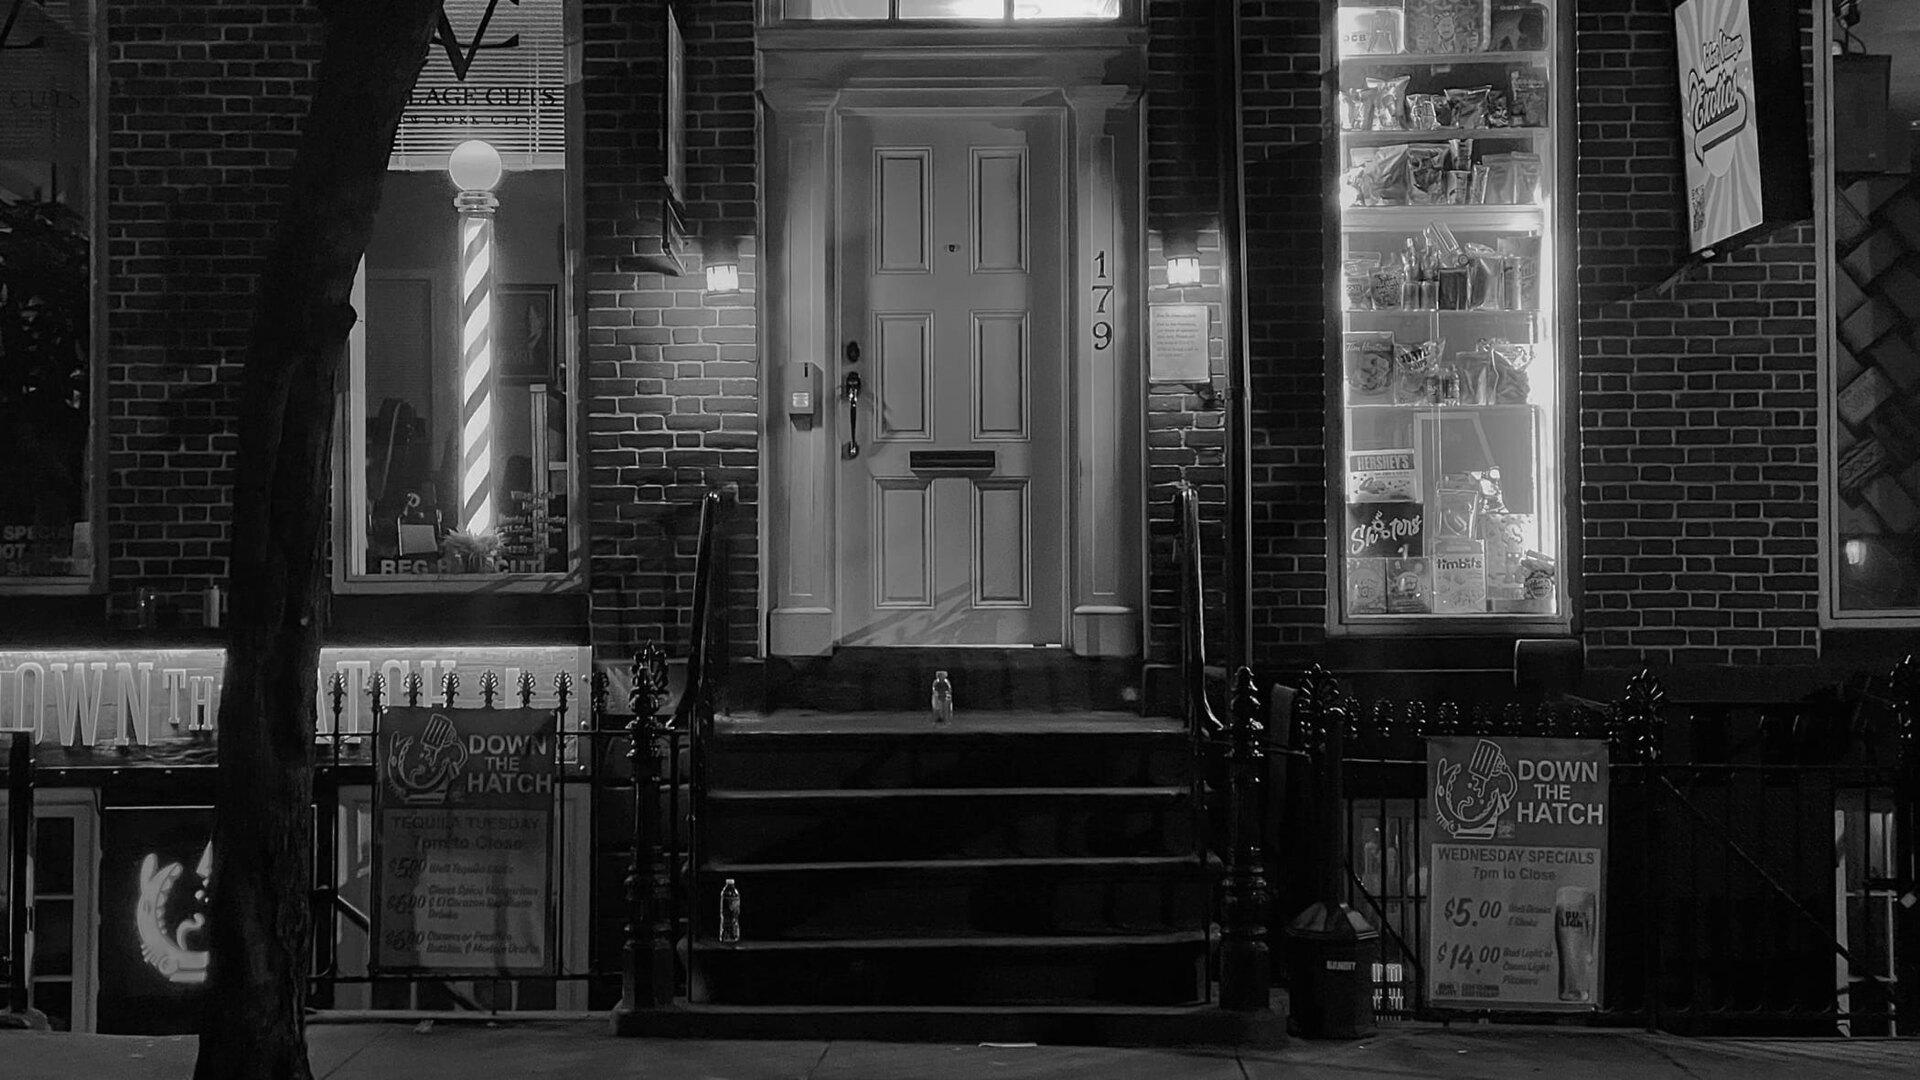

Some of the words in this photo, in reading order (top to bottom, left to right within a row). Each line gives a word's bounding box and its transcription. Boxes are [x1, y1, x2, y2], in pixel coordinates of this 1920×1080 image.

[487, 88, 557, 106] CUTS
[1092, 250, 1114, 350] 179
[1436, 557, 1482, 570] timbits
[468, 734, 547, 755] DOWN
[484, 757, 520, 771] THE
[1518, 760, 1598, 783] DOWN
[467, 772, 551, 793] HATCH
[1534, 784, 1571, 800] THE
[1517, 801, 1603, 825] HATCH
[391, 816, 460, 830] TEQUILA
[467, 816, 539, 830] TUESDAY
[454, 836, 469, 849] to
[1438, 847, 1525, 862] WEDNESDAY
[1528, 850, 1595, 865] SPECIALS
[1472, 867, 1499, 881] 7pm
[1503, 867, 1516, 880] to
[1519, 868, 1557, 881] Close
[1444, 897, 1502, 927] $5.00
[1436, 941, 1500, 974] $14.00
